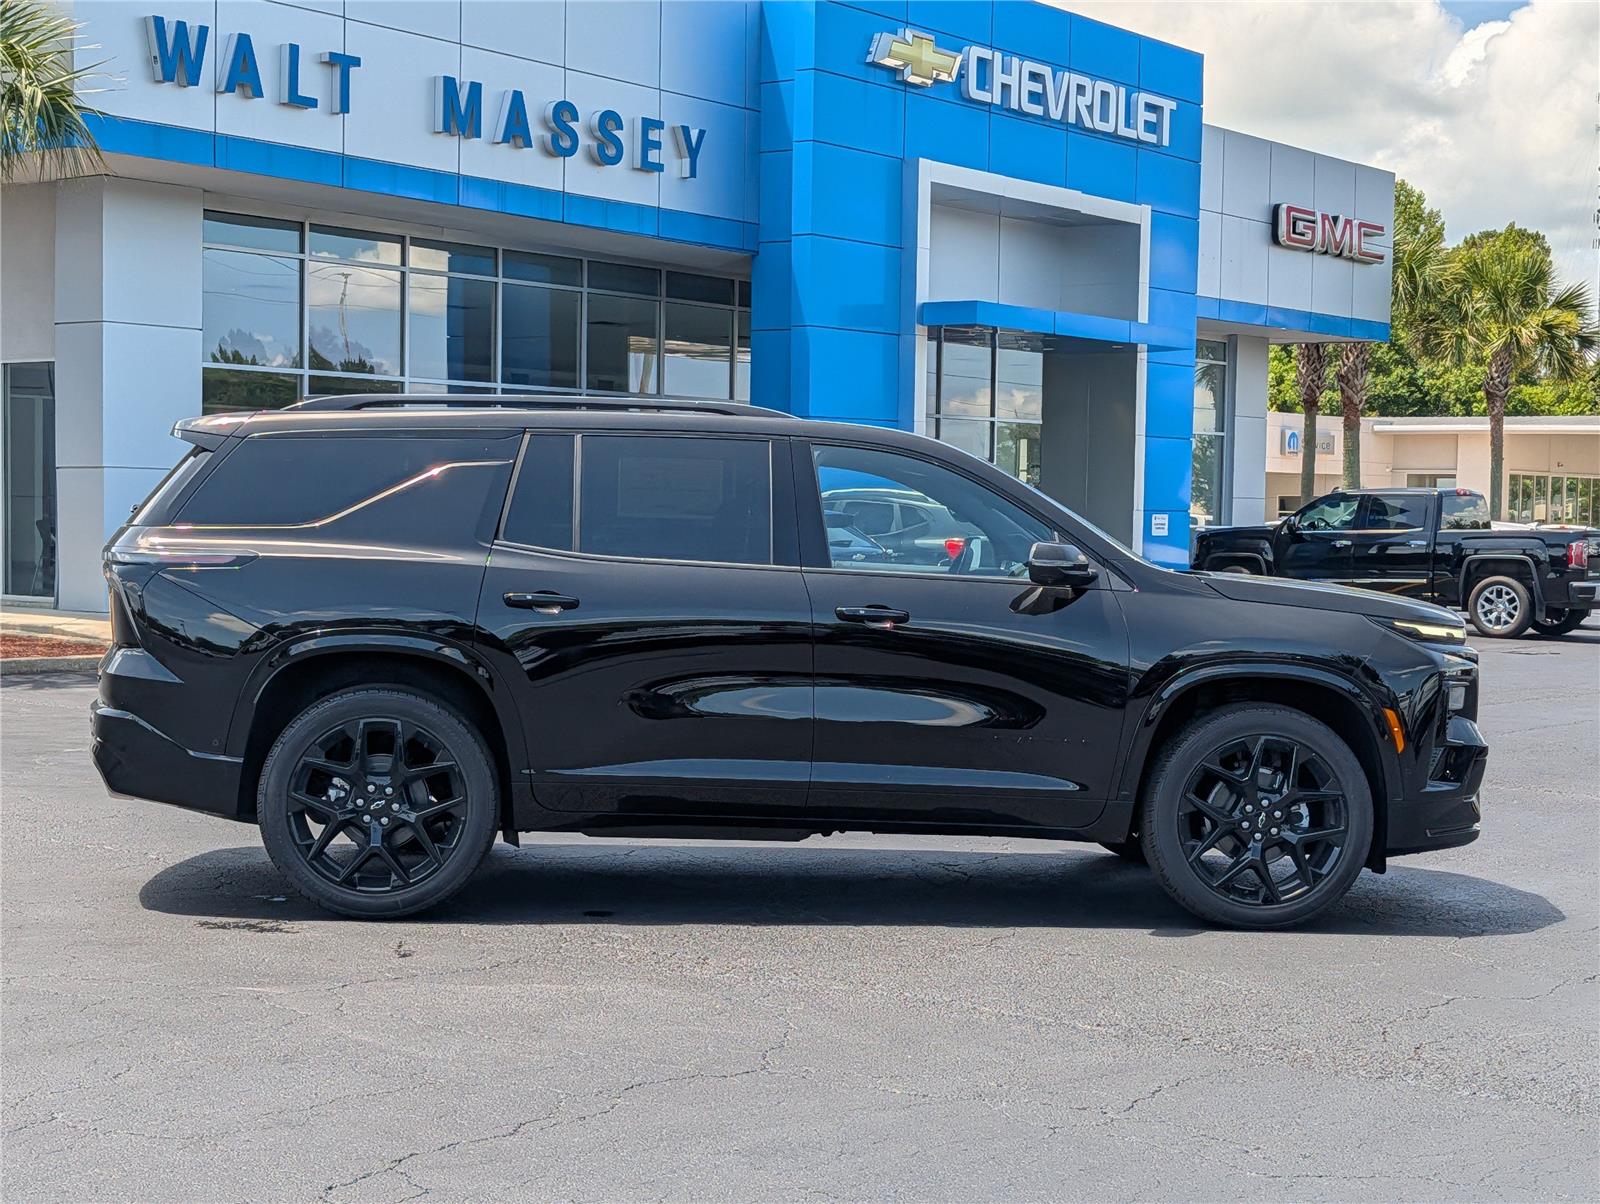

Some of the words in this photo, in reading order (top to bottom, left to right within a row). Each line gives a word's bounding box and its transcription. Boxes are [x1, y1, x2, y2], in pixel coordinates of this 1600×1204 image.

[146, 15, 361, 114] WALT
[435, 75, 707, 179] MASSEY
[961, 46, 1177, 147] CHEVROLET
[1273, 203, 1386, 264] GMC
